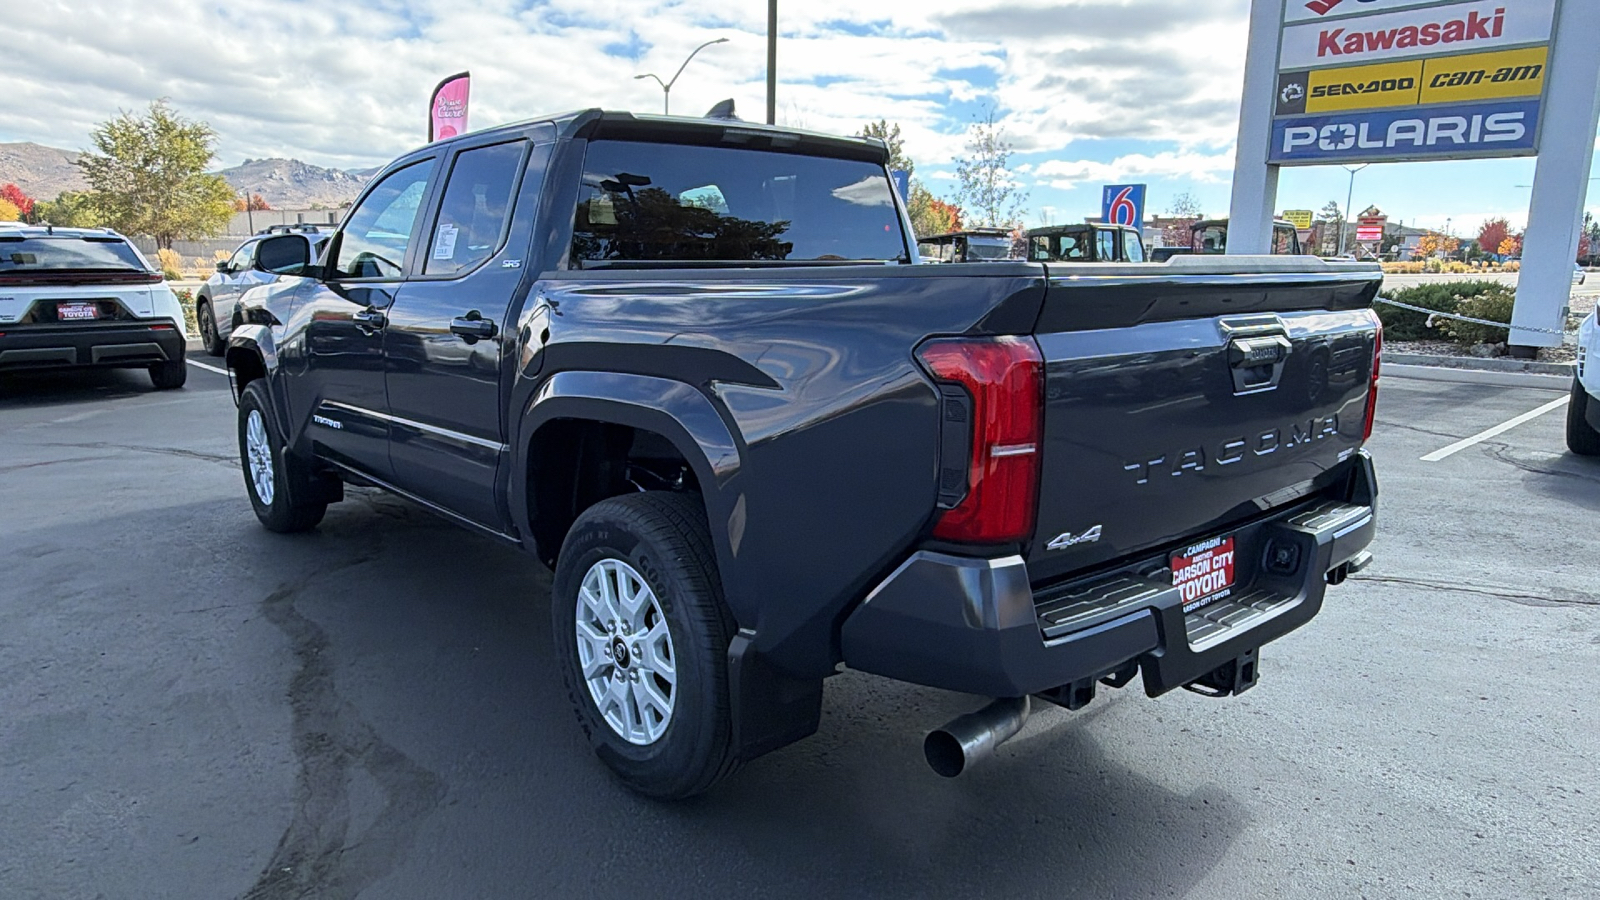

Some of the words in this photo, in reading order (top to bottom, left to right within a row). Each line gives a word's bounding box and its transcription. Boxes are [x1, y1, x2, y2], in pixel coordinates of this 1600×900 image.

[1317, 8, 1505, 57] Kawasaki
[1283, 112, 1525, 153] POLARIS
[1109, 186, 1136, 227] 6
[1124, 413, 1339, 484] TACOMA
[1187, 536, 1221, 556] CAMPAGNI
[1172, 558, 1211, 586] CARSON
[1212, 550, 1234, 570] CITY
[1178, 568, 1227, 603] TOYOTA
[1200, 596, 1212, 607] CITY
[1211, 588, 1231, 601] TOYOTA
